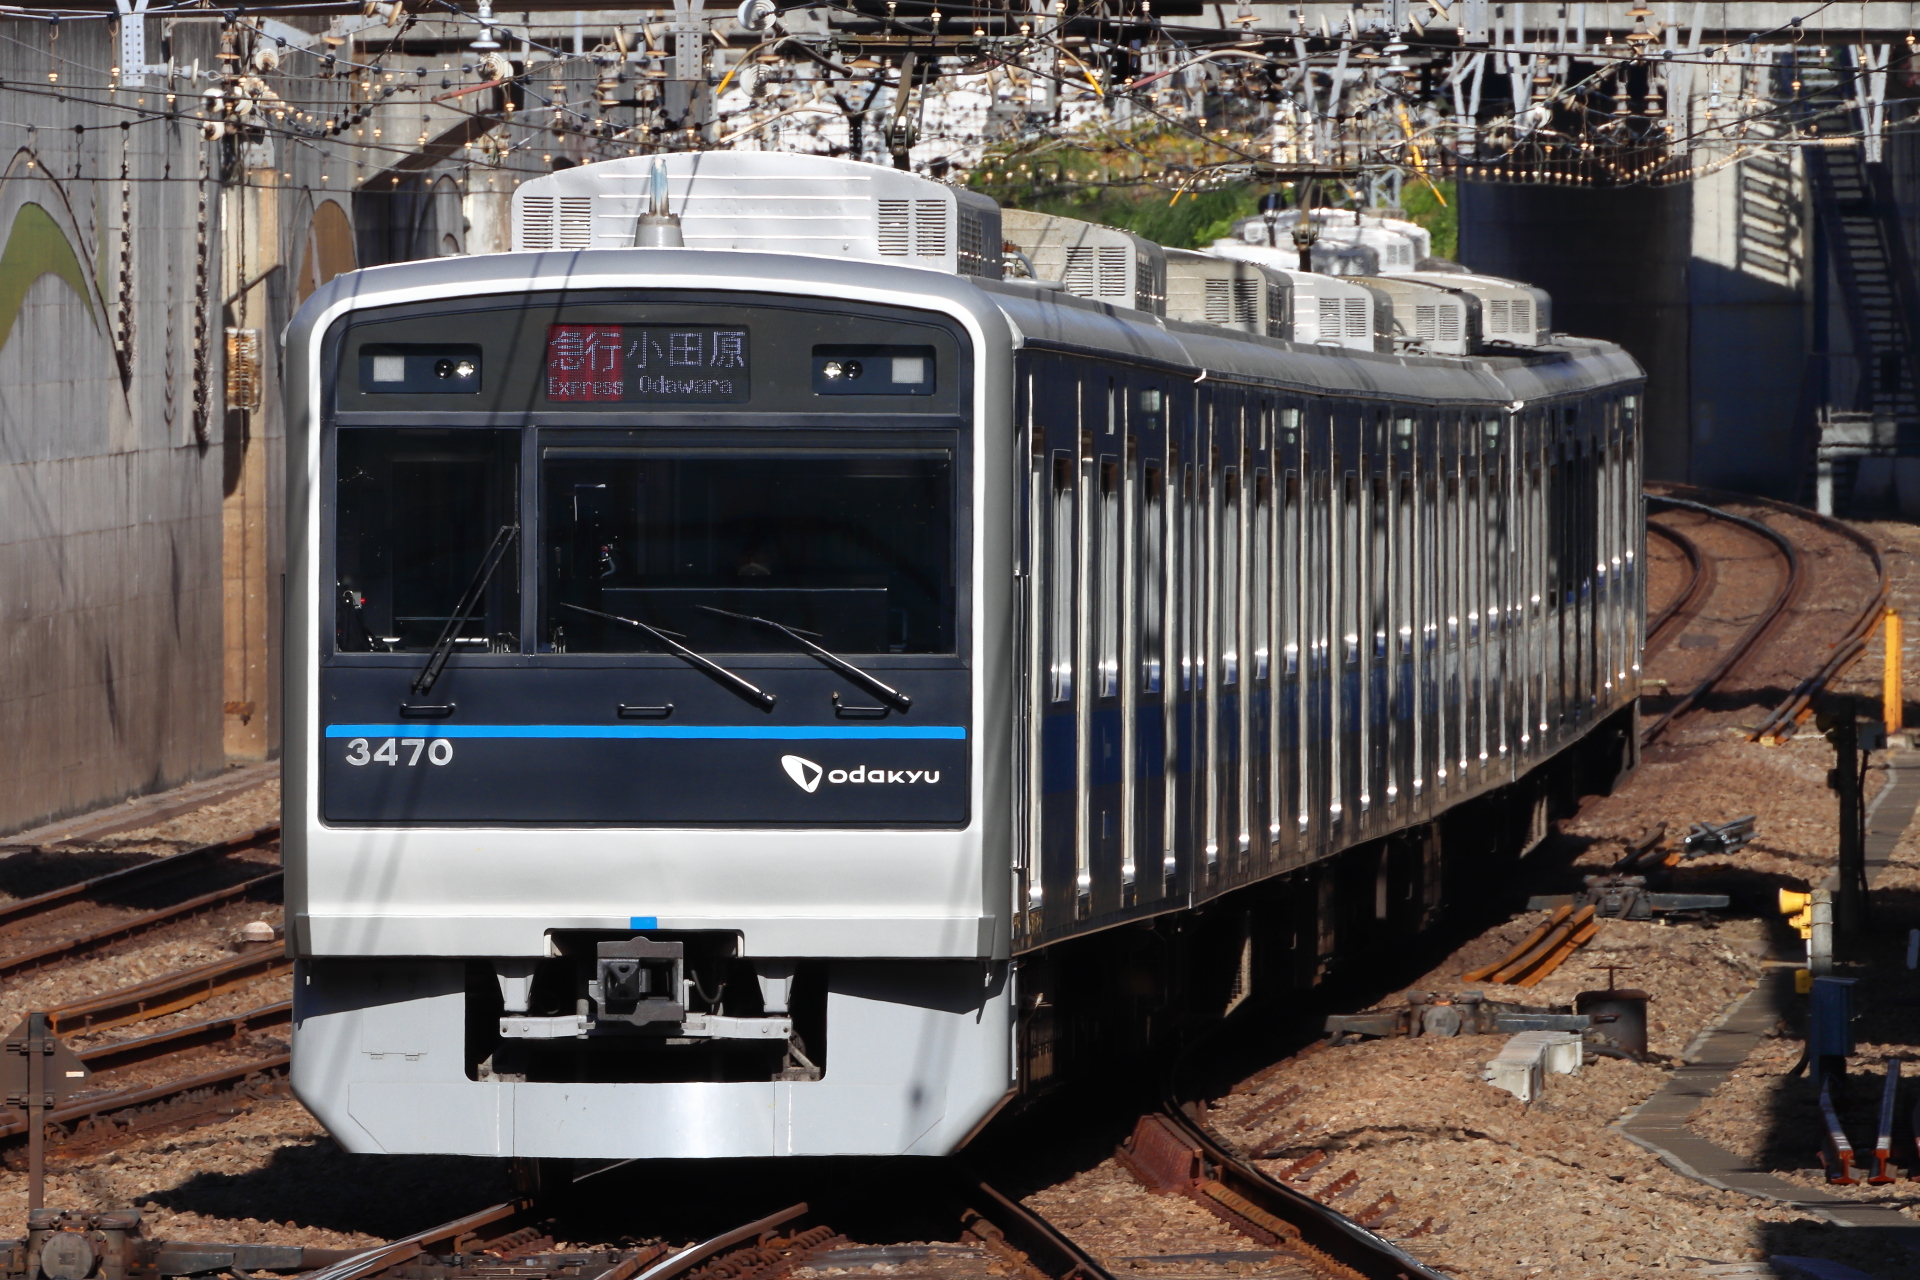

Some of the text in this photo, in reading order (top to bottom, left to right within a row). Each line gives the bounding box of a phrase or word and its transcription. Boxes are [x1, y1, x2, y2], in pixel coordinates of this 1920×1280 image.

[550, 330, 746, 371] 急行 小田原
[549, 375, 733, 396] Express Odawara
[345, 738, 454, 766] 3470
[828, 764, 940, 784] odakyu
